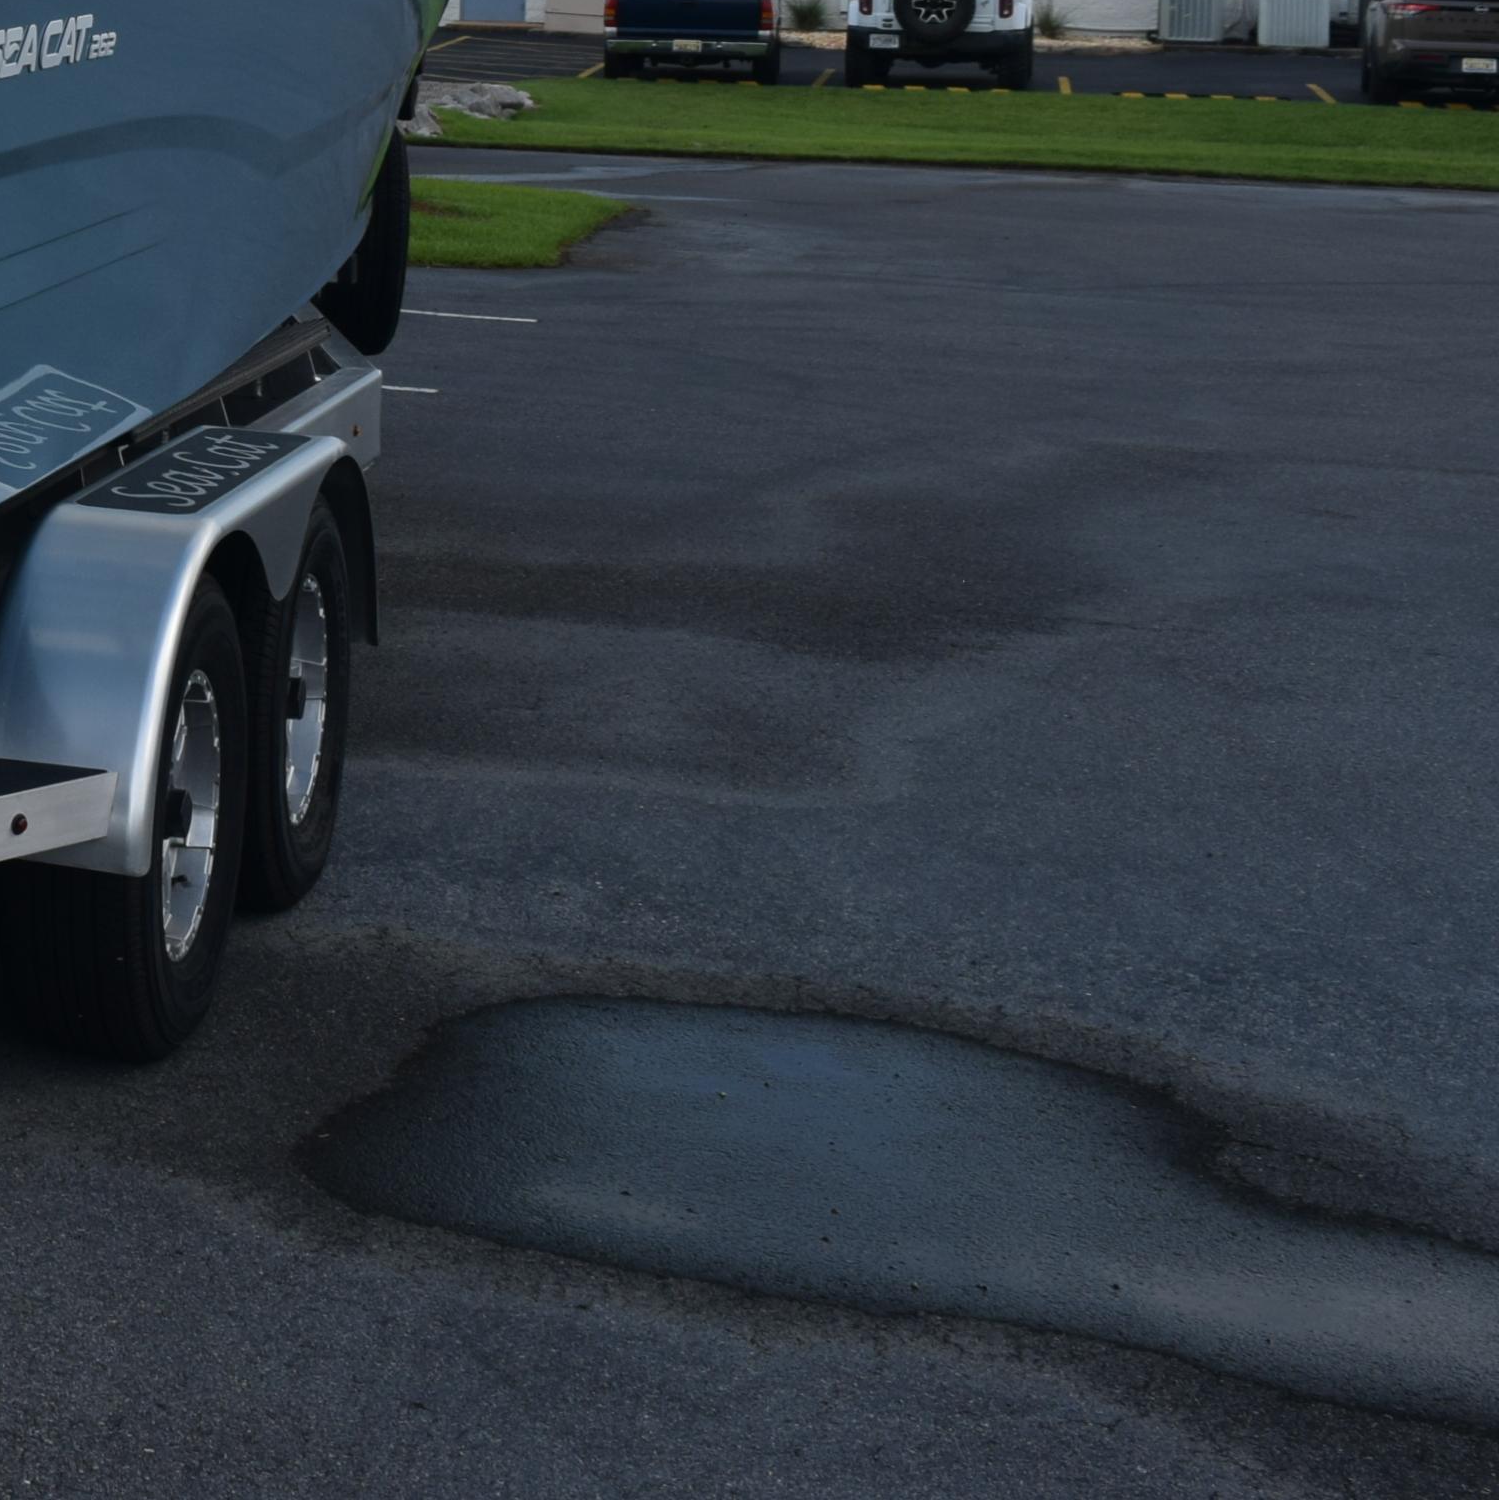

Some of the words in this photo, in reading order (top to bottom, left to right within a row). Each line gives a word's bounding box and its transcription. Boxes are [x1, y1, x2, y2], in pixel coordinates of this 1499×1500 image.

[40, 13, 94, 69] CAT
[111, 465, 225, 507] Sea
[172, 434, 280, 470] Cat
